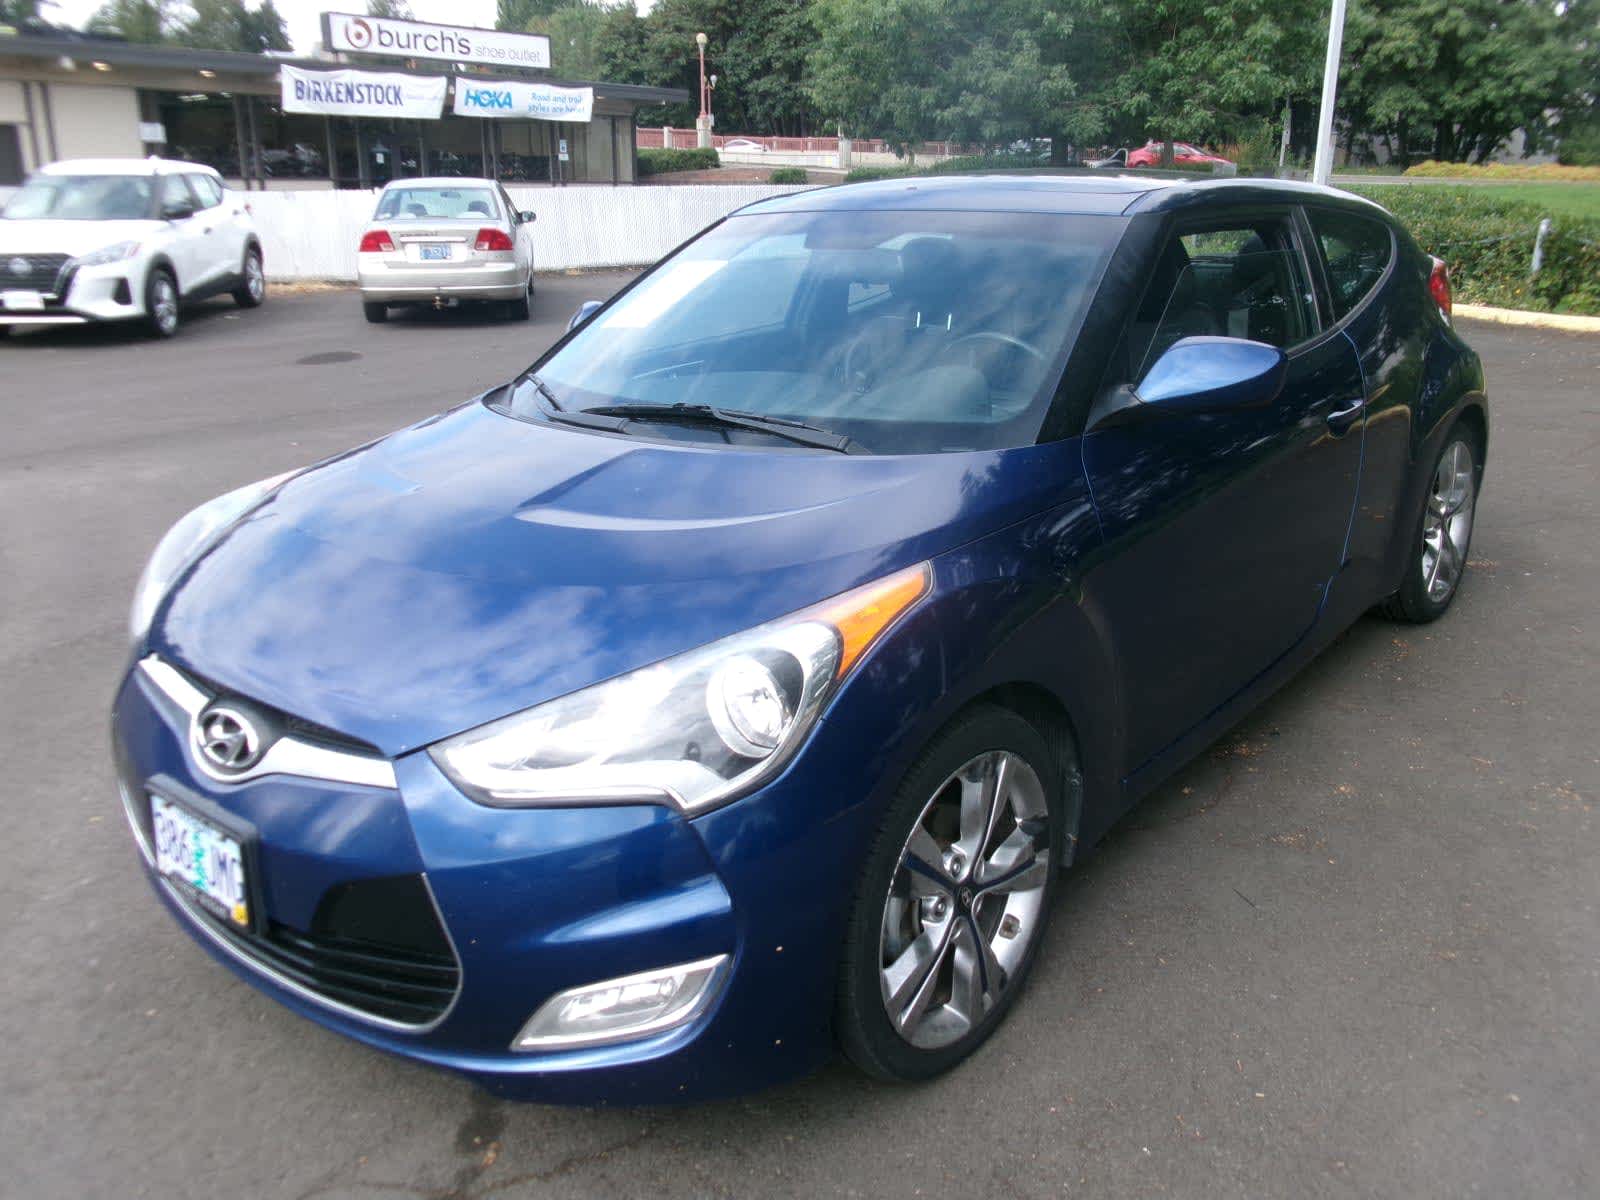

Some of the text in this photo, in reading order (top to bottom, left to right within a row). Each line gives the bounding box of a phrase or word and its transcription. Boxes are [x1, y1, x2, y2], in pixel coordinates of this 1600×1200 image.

[376, 23, 471, 55] burch's
[475, 45, 542, 63] shoe outlet
[295, 79, 403, 105] BIRKENSTOCK
[464, 88, 513, 109] HOKA
